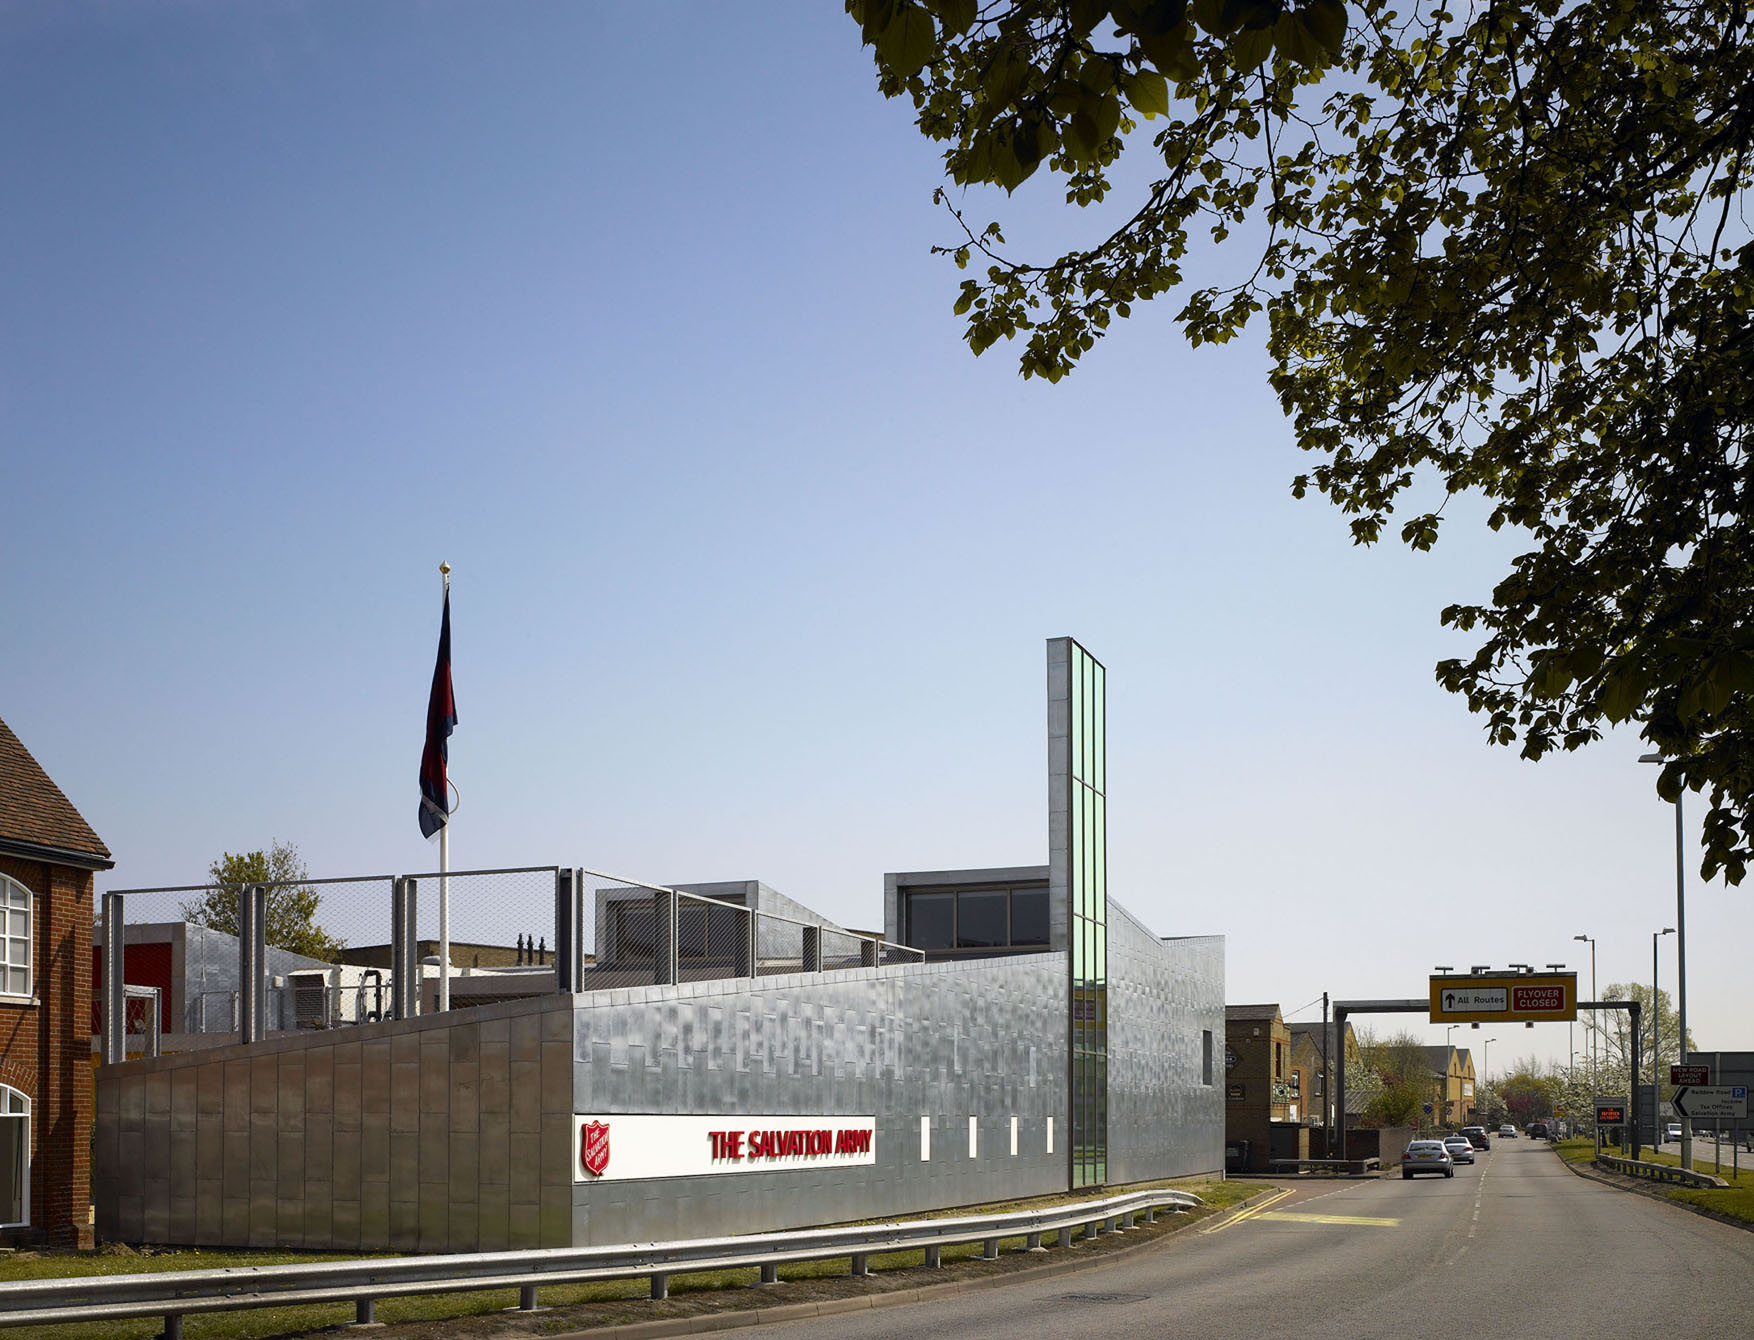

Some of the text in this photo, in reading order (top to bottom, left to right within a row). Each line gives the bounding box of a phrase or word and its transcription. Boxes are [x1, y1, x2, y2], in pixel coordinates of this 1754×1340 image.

[1518, 990, 1559, 998] FLYOVER
[1520, 999, 1558, 1007] CLOSED
[590, 1128, 600, 1144] THE
[709, 1129, 872, 1159] THE SALVATION ARMY
[594, 1144, 608, 1168] ARMY
